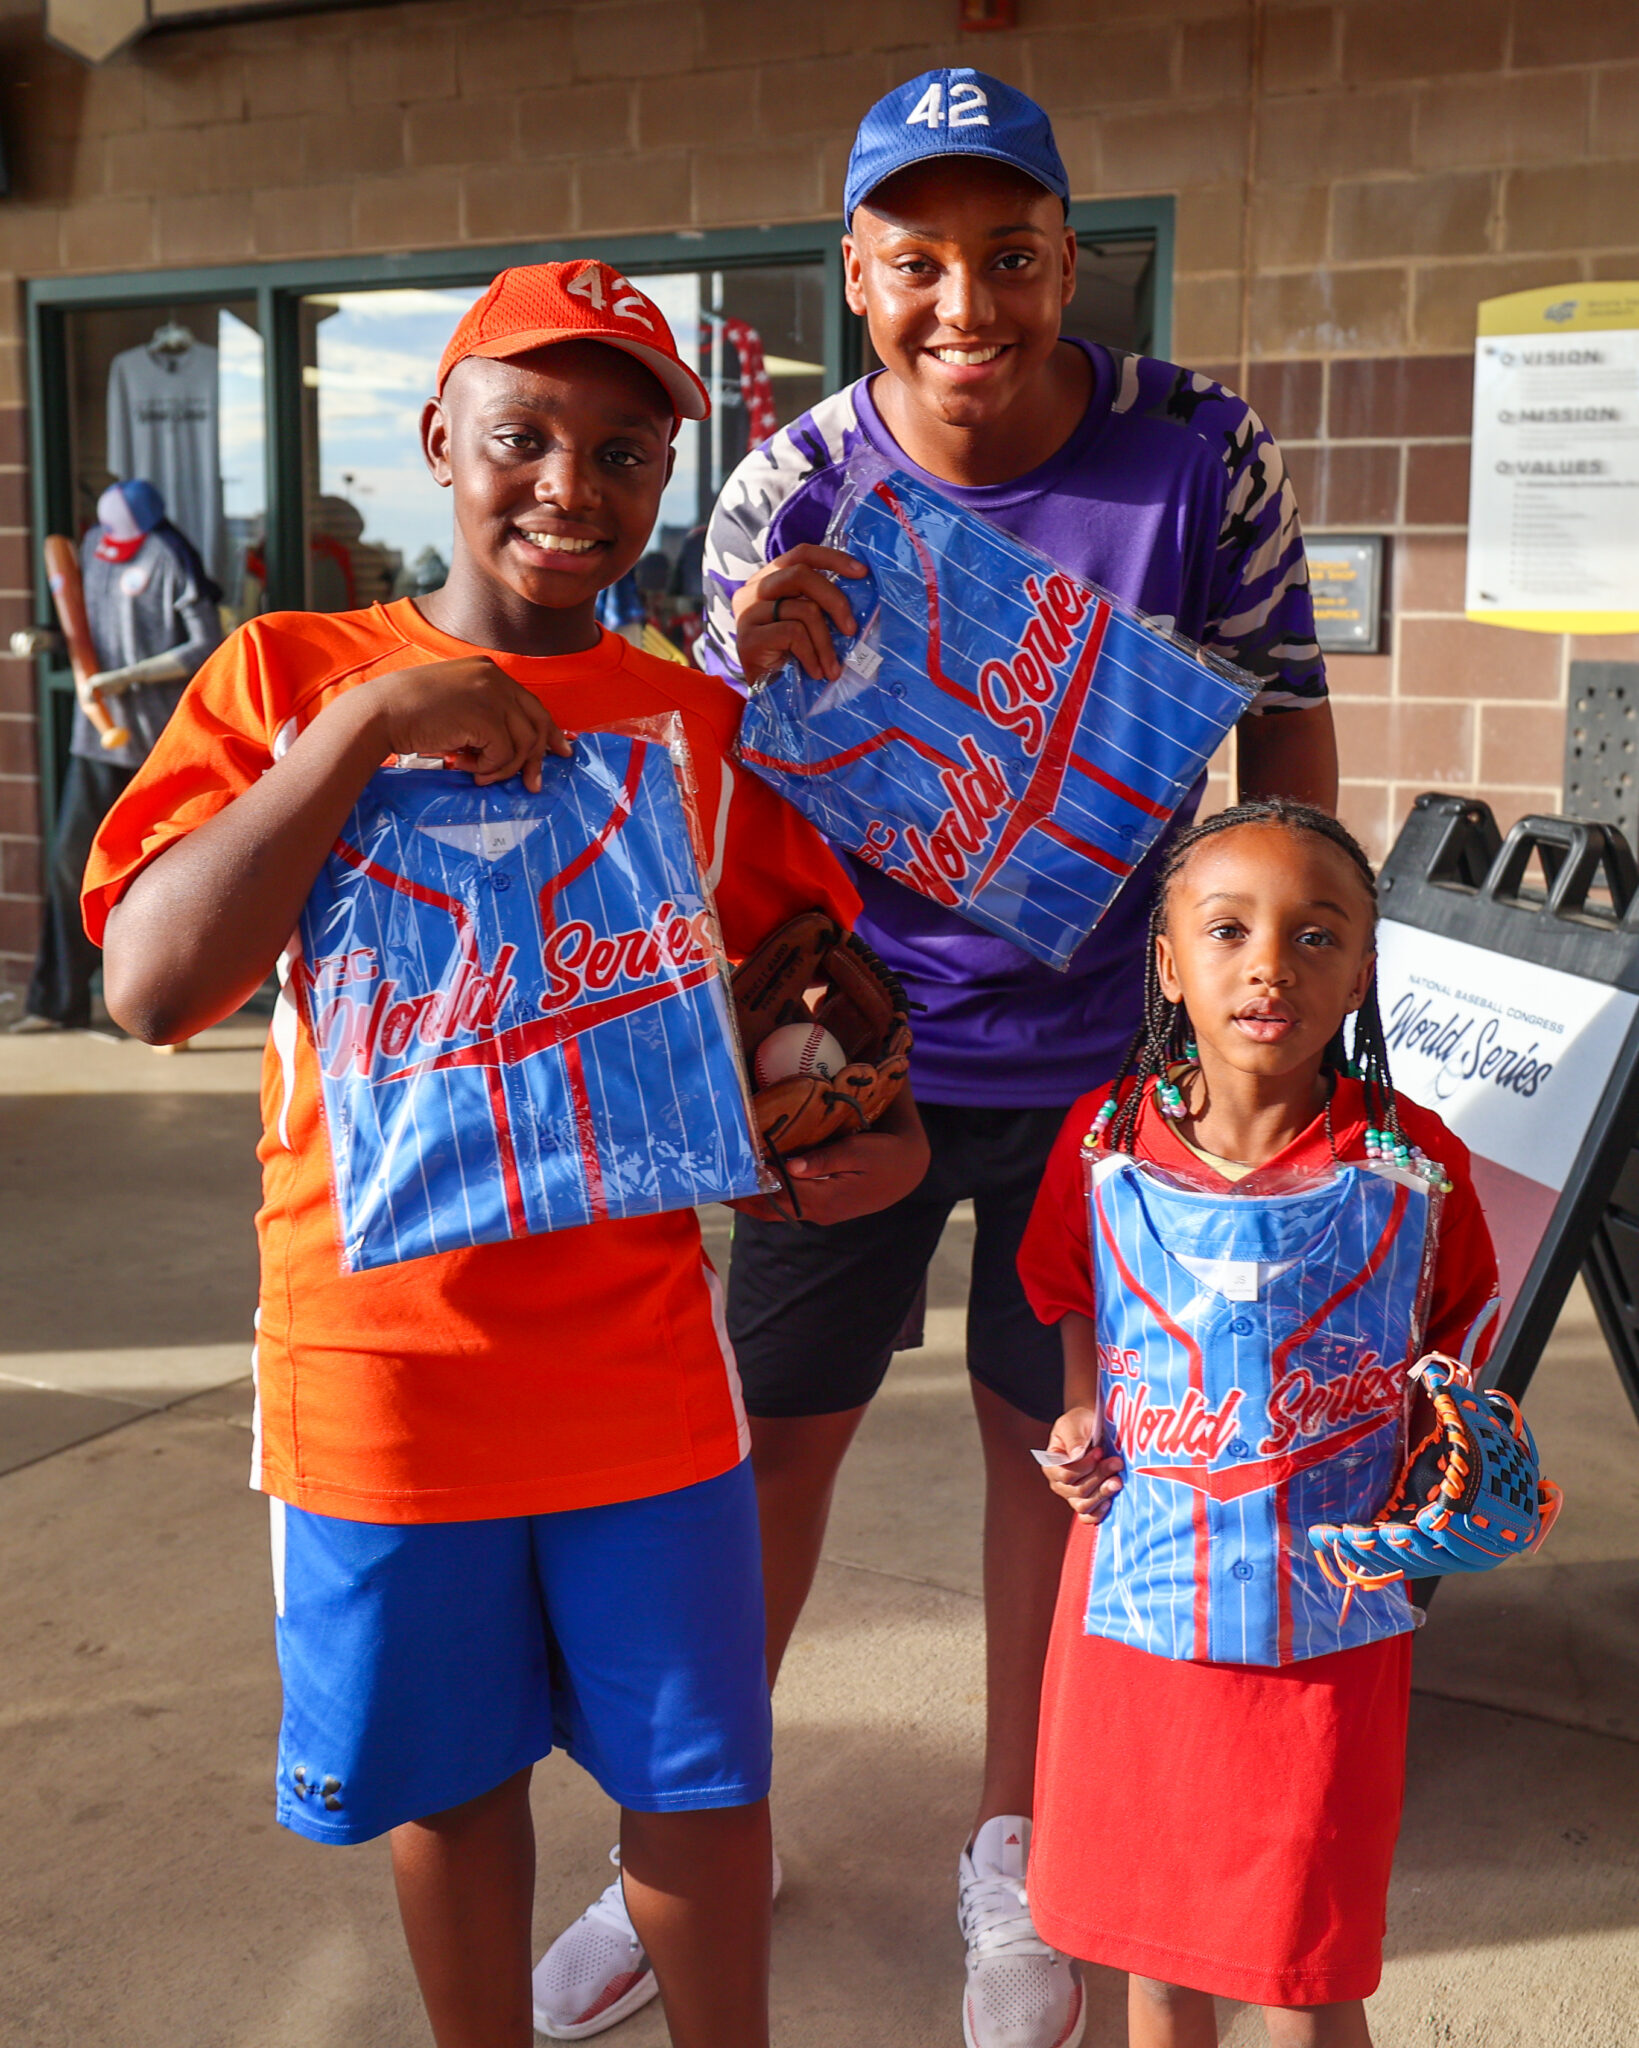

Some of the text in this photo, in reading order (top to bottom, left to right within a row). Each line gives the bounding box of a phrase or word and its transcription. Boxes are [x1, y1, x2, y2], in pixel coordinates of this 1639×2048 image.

[906, 83, 990, 128] 42
[567, 265, 654, 332] 42
[1521, 349, 1605, 367] VISION
[1519, 406, 1621, 423] MISSION
[1516, 459, 1605, 476] VALUES
[885, 733, 1015, 907] World
[316, 942, 520, 1080] World
[1409, 974, 1565, 1034] NATIONAL BASEBALL CONGRESS
[1384, 992, 1552, 1097] World Series
[1105, 1381, 1247, 1464] World
